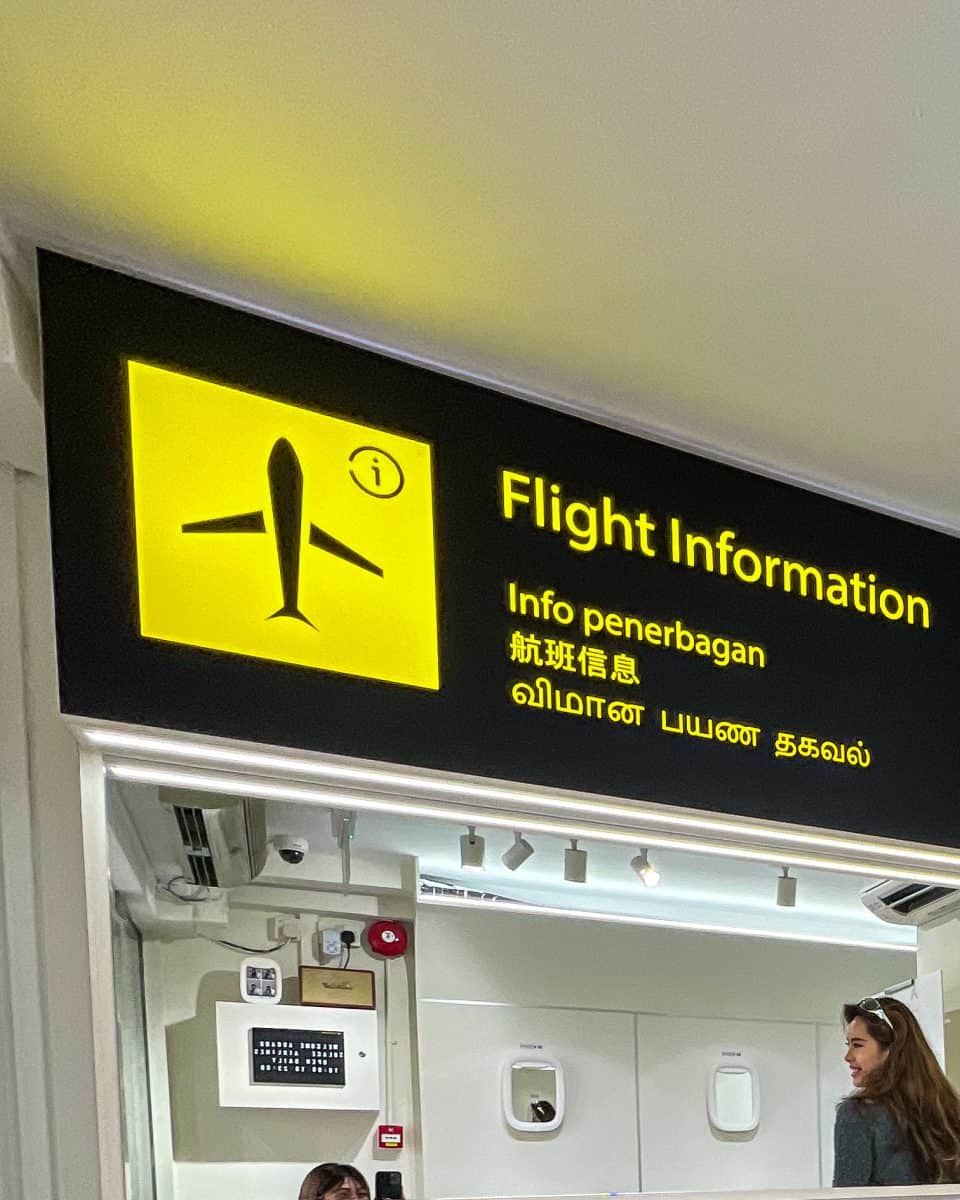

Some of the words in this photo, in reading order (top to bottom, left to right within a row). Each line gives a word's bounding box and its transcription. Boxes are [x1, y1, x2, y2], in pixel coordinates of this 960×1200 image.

[501, 469, 657, 558] Flight
[670, 516, 931, 629] Information
[508, 581, 575, 625] Info
[583, 606, 766, 668] penerbagan
[509, 630, 642, 685] 航班信息
[511, 676, 646, 727] விமான
[660, 709, 761, 748] பயண
[774, 732, 872, 768] தகவல்
